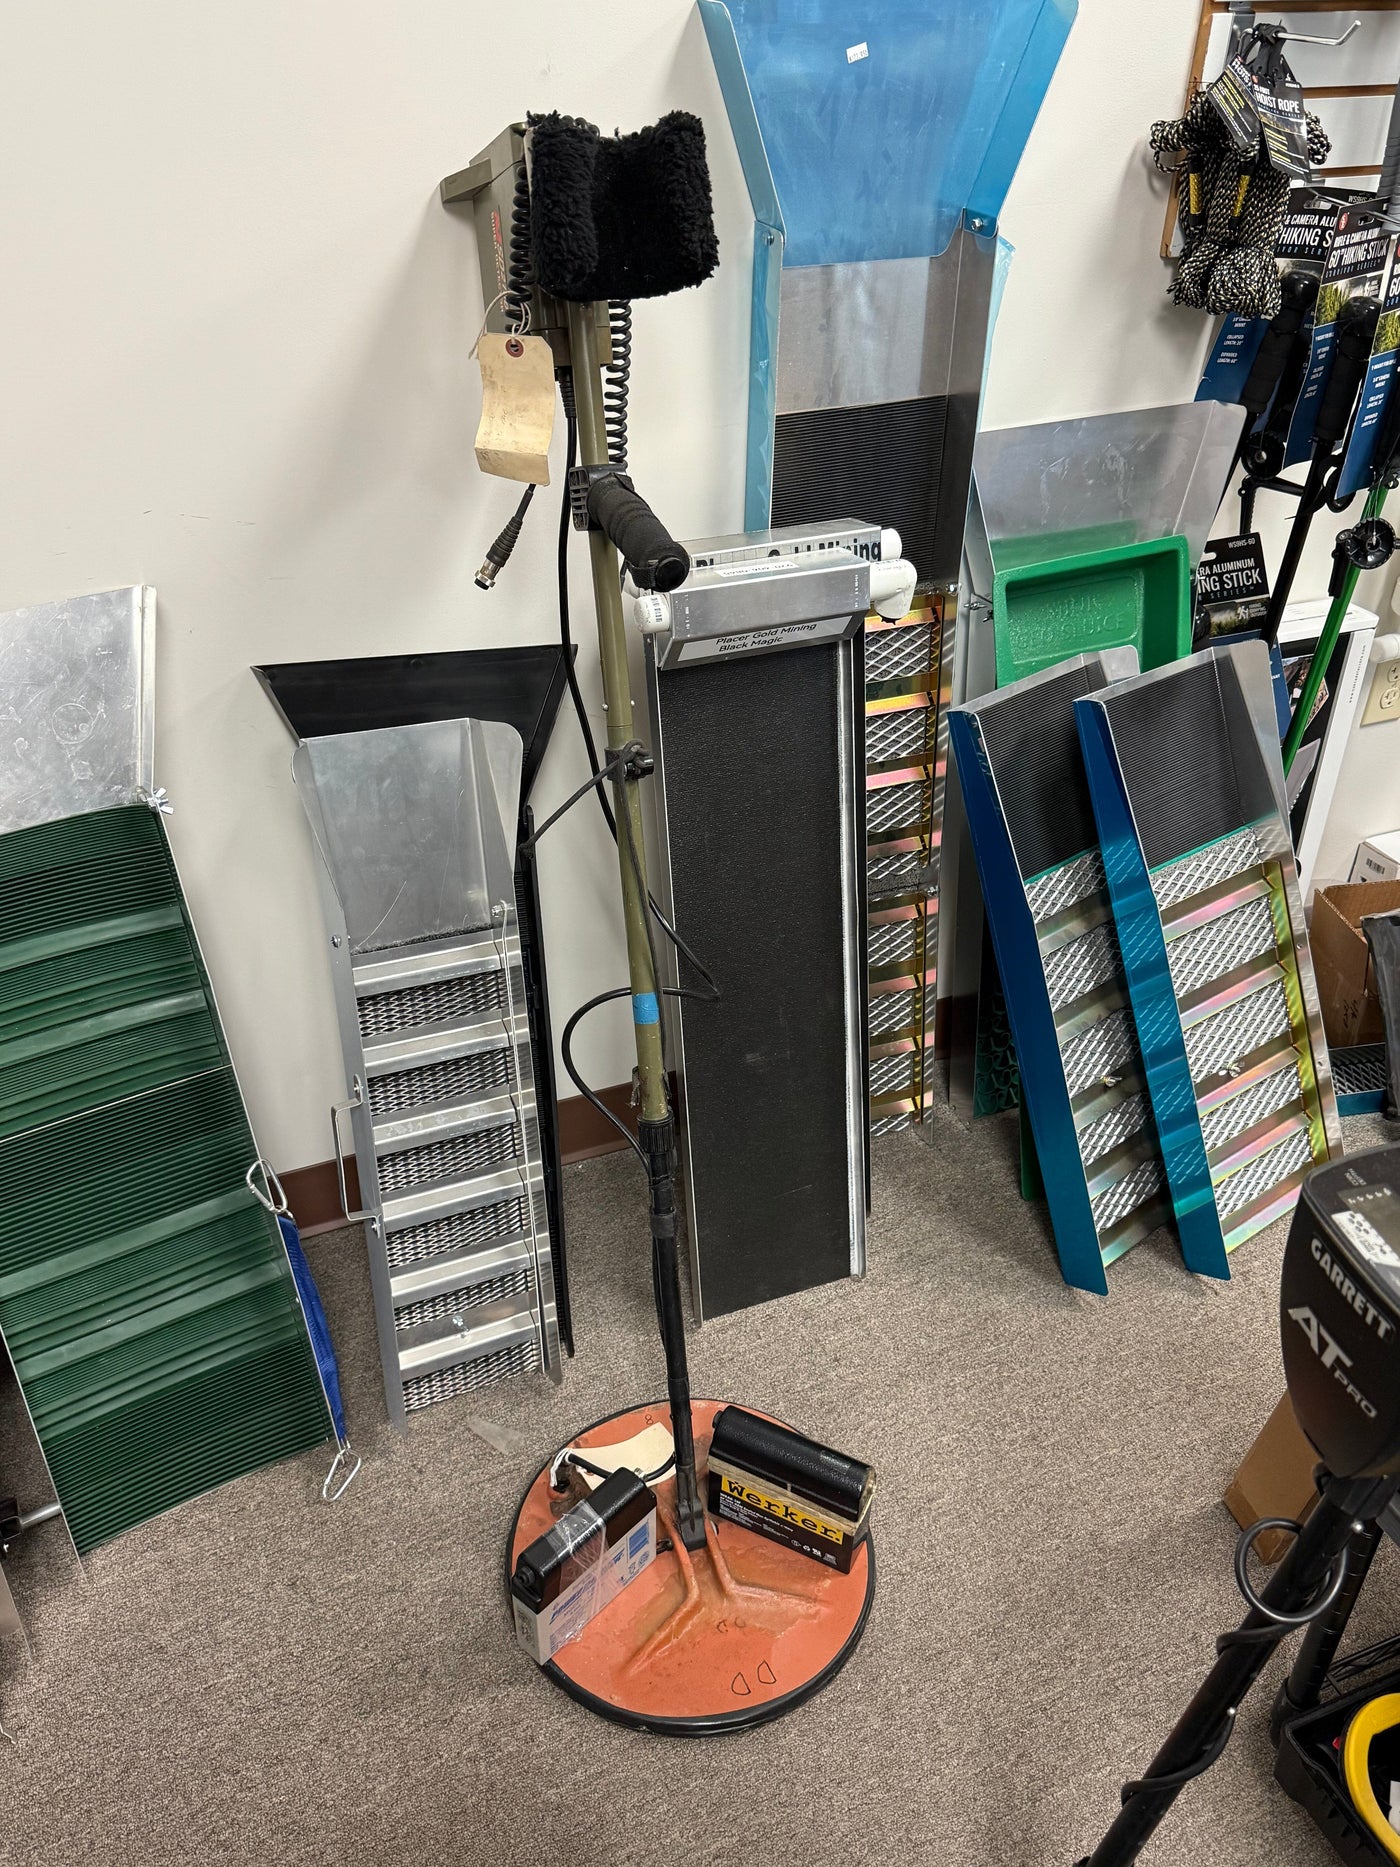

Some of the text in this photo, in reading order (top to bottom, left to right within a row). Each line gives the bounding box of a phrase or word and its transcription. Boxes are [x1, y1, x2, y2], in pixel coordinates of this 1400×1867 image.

[1278, 98, 1301, 114] ROPE
[1290, 214, 1319, 225] CAMERA
[1367, 238, 1389, 259] STICK
[1213, 558, 1255, 573] ALUMINUM
[1223, 568, 1262, 589] STICK
[716, 622, 817, 645] Placer Gold Mining
[719, 636, 783, 652] Black Magic
[1311, 1238, 1390, 1339] GARRETT
[1288, 1306, 1379, 1418] AT PRO
